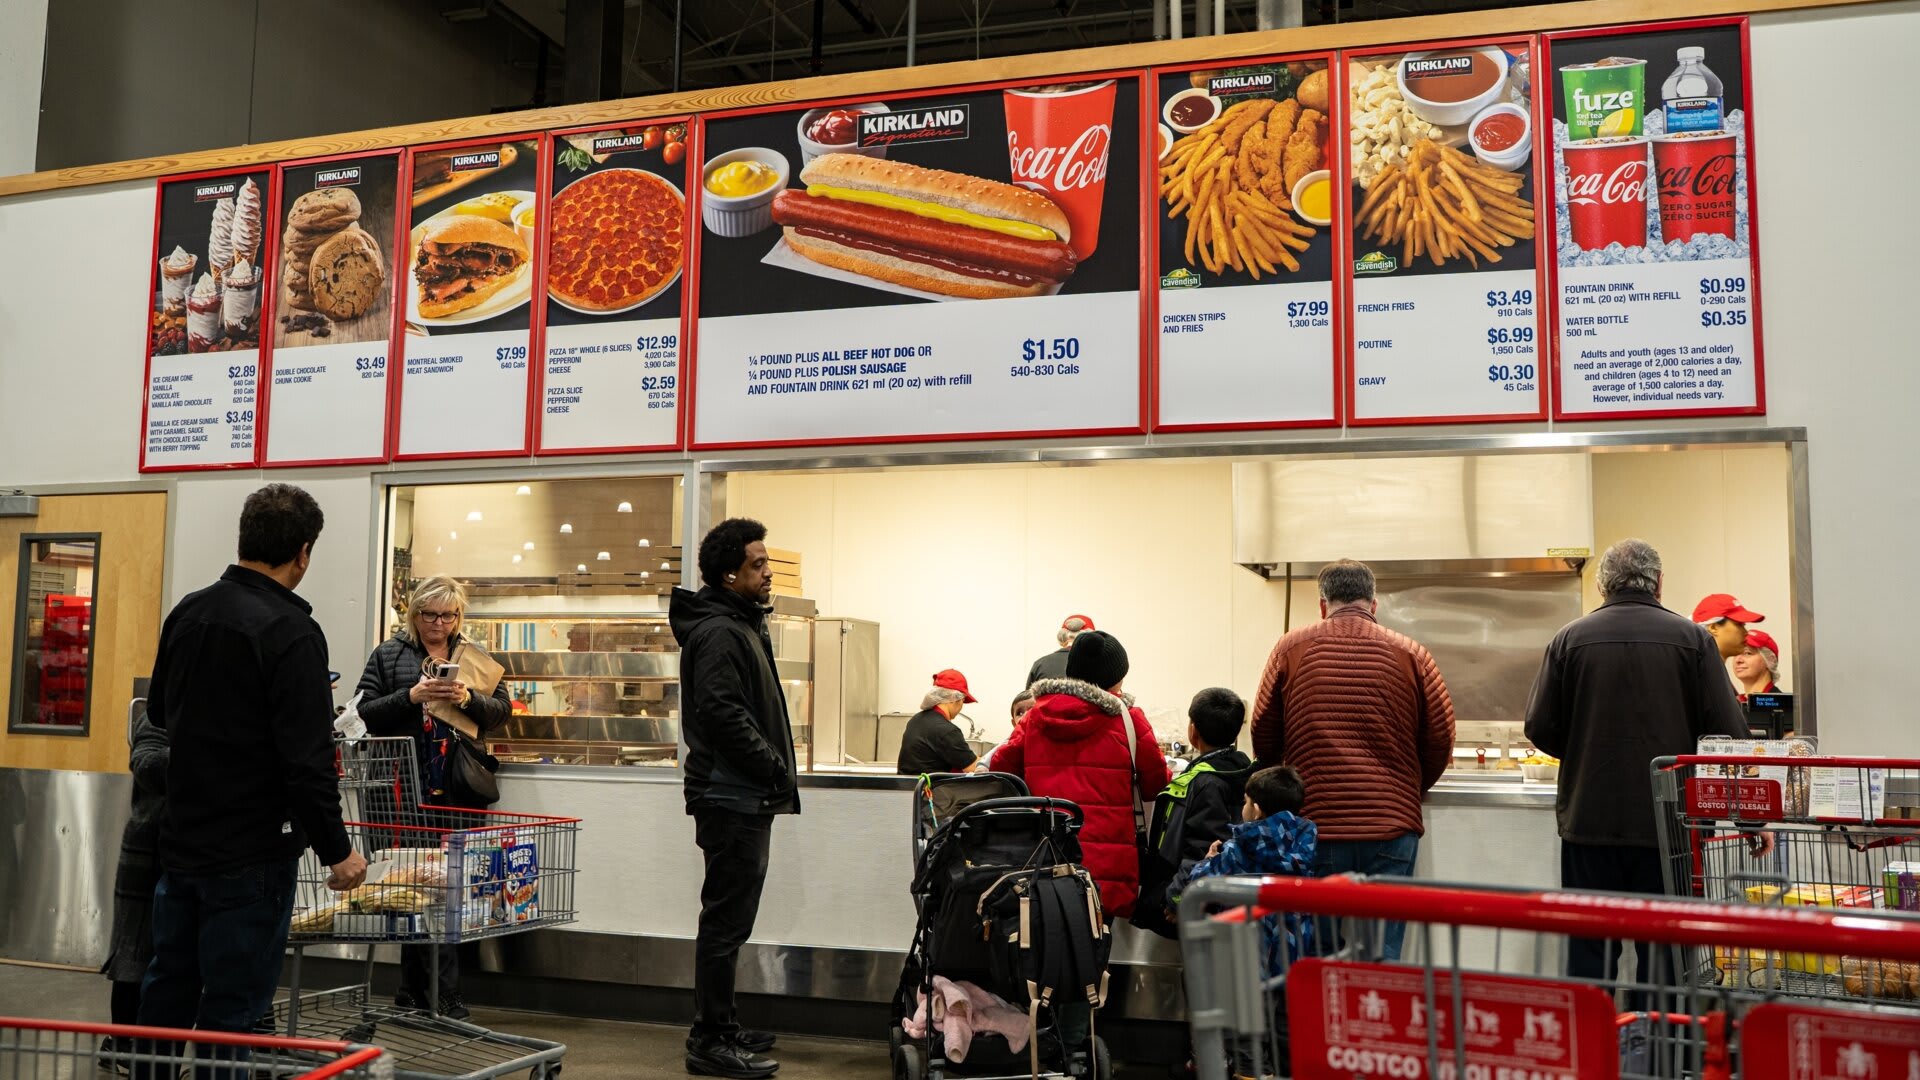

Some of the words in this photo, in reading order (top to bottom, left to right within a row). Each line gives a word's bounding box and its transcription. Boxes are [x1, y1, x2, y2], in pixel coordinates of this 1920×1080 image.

[1408, 58, 1470, 72] KIRKLAND
[1212, 75, 1272, 89] KIRKLAND
[1573, 88, 1634, 112] fuze
[864, 110, 964, 134] KIRKLAND
[596, 136, 642, 148] KIRKLAND
[864, 129, 964, 147] Signature
[454, 154, 497, 166] KIRKLAND
[318, 170, 358, 182] KIRKLAND
[197, 185, 234, 196] KIRKLAND
[1663, 203, 1692, 211] ZERO
[1696, 200, 1732, 210] SUGAR
[1696, 210, 1732, 220] SUCRE
[1356, 260, 1394, 270] Cavendish
[1162, 276, 1198, 286] Cavendish
[1700, 277, 1745, 296] $0.99
[1565, 284, 1606, 294] FOUNTAIN
[1608, 283, 1634, 291] DRINK
[1487, 290, 1532, 308] $3.49
[1565, 297, 1579, 305] 621
[1583, 296, 1596, 304] mL
[1598, 295, 1611, 304] (20
[1614, 294, 1626, 304] oz)
[1628, 293, 1650, 301] WITH
[1653, 292, 1681, 300] REFILL
[1700, 296, 1725, 305] 0-290
[1728, 295, 1746, 304] Cals
[1288, 301, 1328, 319] $7.99
[1358, 304, 1389, 312] FRENCH
[1392, 302, 1415, 311] FRIES
[1498, 308, 1512, 317] 910
[1515, 308, 1532, 316] Cals
[1163, 313, 1196, 323] CHICKEN
[1199, 312, 1226, 322] STRIPS
[1289, 319, 1309, 328] 1,300
[1312, 318, 1328, 327] Cals
[1566, 317, 1594, 326] WATER
[1597, 315, 1628, 324] BOTTLE
[1702, 310, 1746, 328] $0.35
[1163, 325, 1179, 333] AND
[1182, 324, 1203, 332] FRIES
[1566, 329, 1582, 337] 500
[1584, 328, 1597, 336] mL
[1488, 327, 1533, 345] $6.99
[602, 345, 608, 354] (6
[609, 344, 632, 353] SLICES)
[637, 335, 676, 352] $12.99
[1358, 340, 1392, 349] POUTINE
[496, 346, 526, 361] $7.99
[760, 354, 792, 365] POUND
[795, 352, 819, 363] PLUS
[822, 351, 840, 362] ALL
[844, 349, 868, 360] BEEF
[871, 348, 891, 359] HOT
[894, 347, 915, 358] DOG
[918, 346, 932, 356] OR
[1023, 338, 1079, 363] $1.50
[1492, 346, 1513, 355] 1,950
[1516, 345, 1534, 353] Cals
[1581, 350, 1607, 358] Adults
[1610, 349, 1625, 357] and
[1628, 348, 1651, 358] youth
[1654, 348, 1676, 357] (ages
[1679, 346, 1688, 354] 13
[1691, 346, 1706, 354] and
[1709, 344, 1733, 354] older)
[356, 356, 385, 371] $3.49
[439, 356, 463, 364] SMOKED
[549, 356, 581, 365] PEPPERONI
[1574, 361, 1594, 370] need
[1609, 361, 1642, 369] average
[1644, 359, 1653, 367] of
[1655, 358, 1678, 368] 2,000
[1681, 357, 1714, 366] calories
[1725, 356, 1742, 365] day,
[228, 365, 256, 379] $2.89
[276, 368, 295, 376] DOUBLE
[297, 366, 326, 374] CHOCOLATE
[549, 366, 571, 374] CHEESE
[760, 368, 792, 380] POUND
[795, 367, 819, 378] PLUS
[822, 365, 856, 376] POLISH
[860, 362, 906, 374] SAUSAGE
[1011, 365, 1054, 376] 540-830
[1057, 364, 1079, 374] Cals
[1489, 364, 1534, 382] $0.30
[1584, 372, 1600, 381] and
[1602, 371, 1636, 380] children
[1639, 371, 1661, 380] (ages
[1683, 369, 1695, 378] 12)
[1698, 368, 1718, 376] need
[642, 376, 675, 391] $2.59
[748, 384, 768, 395] AND
[771, 382, 816, 394] FOUNTAIN
[820, 380, 849, 391] DRINK
[852, 379, 868, 390] 621
[873, 378, 885, 389] ml
[889, 378, 904, 390] (20
[907, 376, 921, 389] oz)
[924, 376, 946, 386] with
[950, 374, 971, 385] refill
[1359, 377, 1386, 386] GRAVY
[1504, 383, 1514, 391] 45
[1517, 383, 1534, 391] Cals
[1592, 384, 1625, 392] average
[1628, 382, 1636, 390] of
[1639, 381, 1661, 391] 1,500
[1664, 380, 1696, 389] calories
[1707, 379, 1724, 388] day.
[548, 396, 580, 404] PEPPERONI
[1593, 394, 1630, 402] However,
[1633, 392, 1673, 401] individual
[1676, 391, 1701, 399] needs
[1704, 392, 1724, 400] vary.
[226, 410, 253, 424] $3.49
[1327, 1046, 1420, 1078] COSTCO
